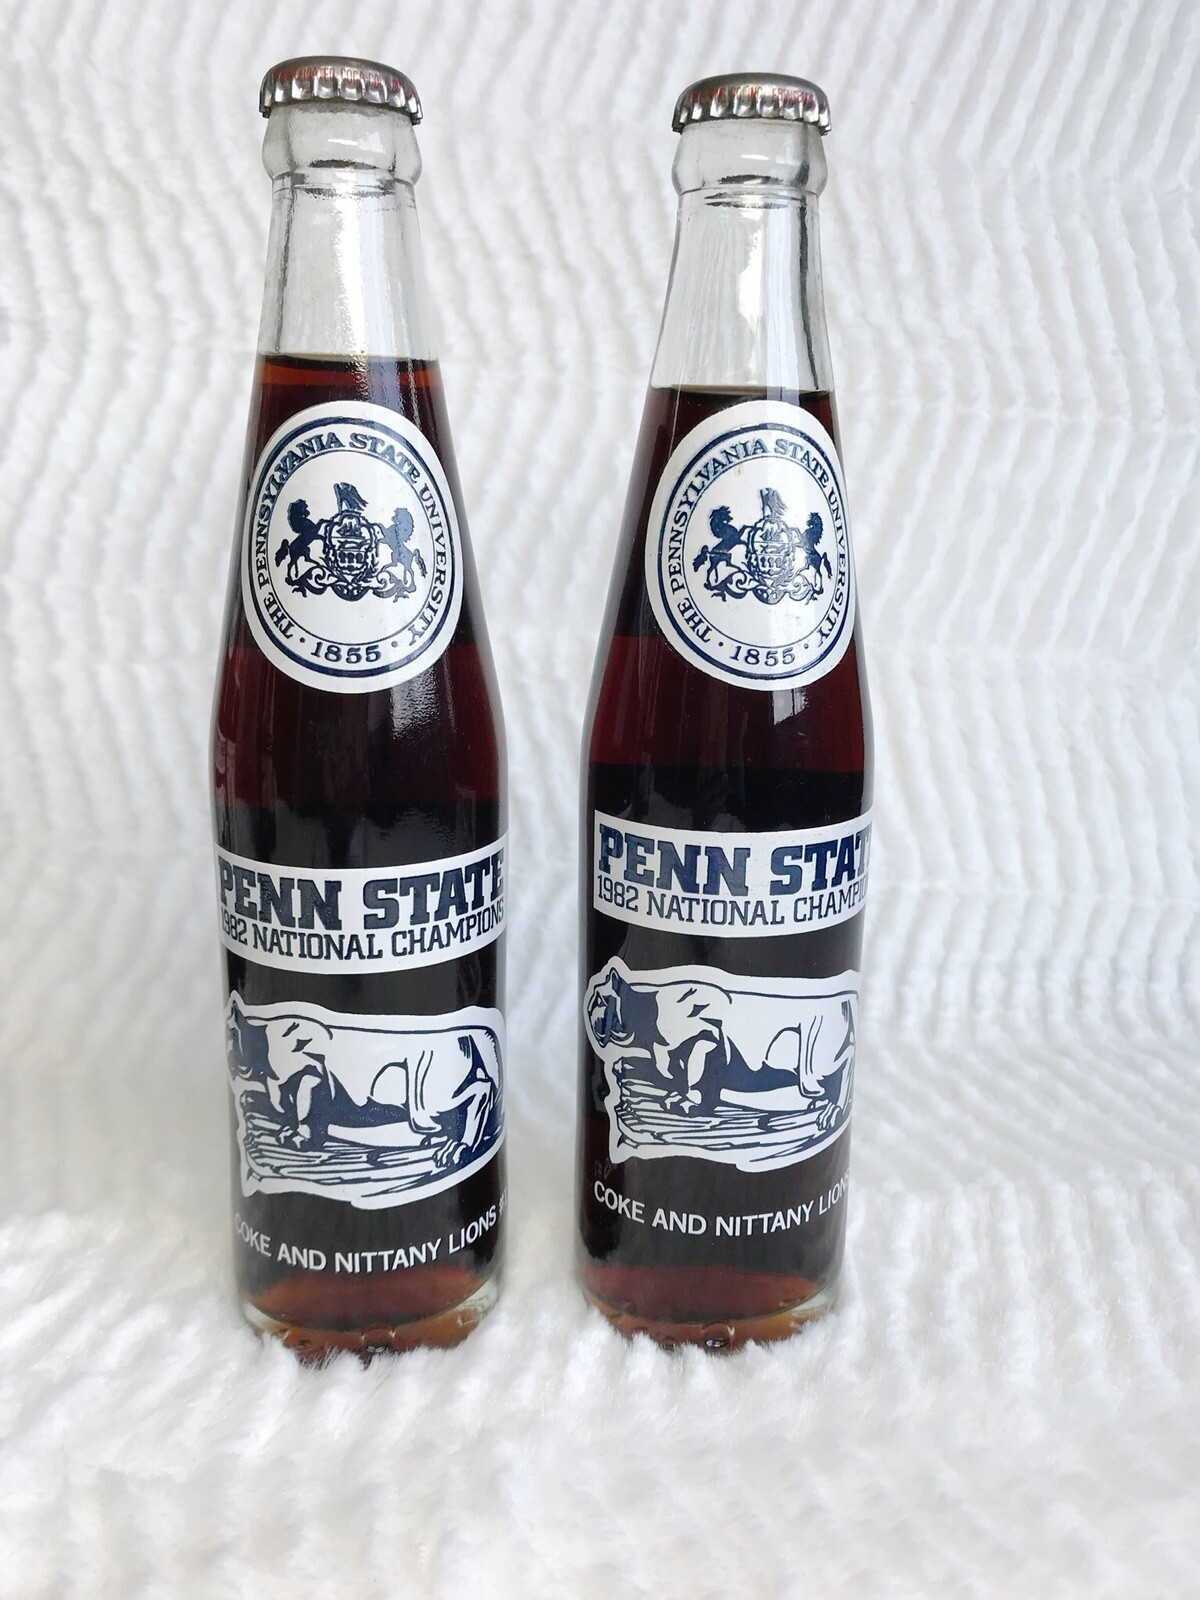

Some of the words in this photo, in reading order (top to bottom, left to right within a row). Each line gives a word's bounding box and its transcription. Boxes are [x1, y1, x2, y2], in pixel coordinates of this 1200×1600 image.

[348, 432, 421, 485] STATE
[773, 438, 830, 489] STATE
[253, 431, 346, 590] PENNSYLVANIA
[667, 438, 770, 595] PENNSYLVANIA
[409, 482, 447, 647] UNIVERSITY
[817, 486, 847, 649] UNIVERSITY
[263, 592, 295, 640] THE
[677, 596, 713, 644] THE
[311, 640, 382, 664] 1855
[729, 645, 796, 667] 1855
[218, 855, 343, 931] PENN
[362, 846, 505, 931] STATE
[599, 823, 752, 897] PENN
[769, 824, 873, 895] STAT
[220, 905, 248, 946] 1982
[252, 923, 384, 960] NATIONAL
[391, 898, 505, 957] CHAMPIONS
[597, 874, 640, 913] 1982
[646, 890, 786, 926] NATIONAL
[594, 1180, 646, 1224] COKE
[652, 1208, 707, 1236] AND
[715, 1200, 815, 1237] NITTANY
[234, 1212, 272, 1258] COKE
[277, 1242, 328, 1271] AND
[335, 1238, 443, 1273] NITTANY
[448, 1204, 497, 1255] LIONS
